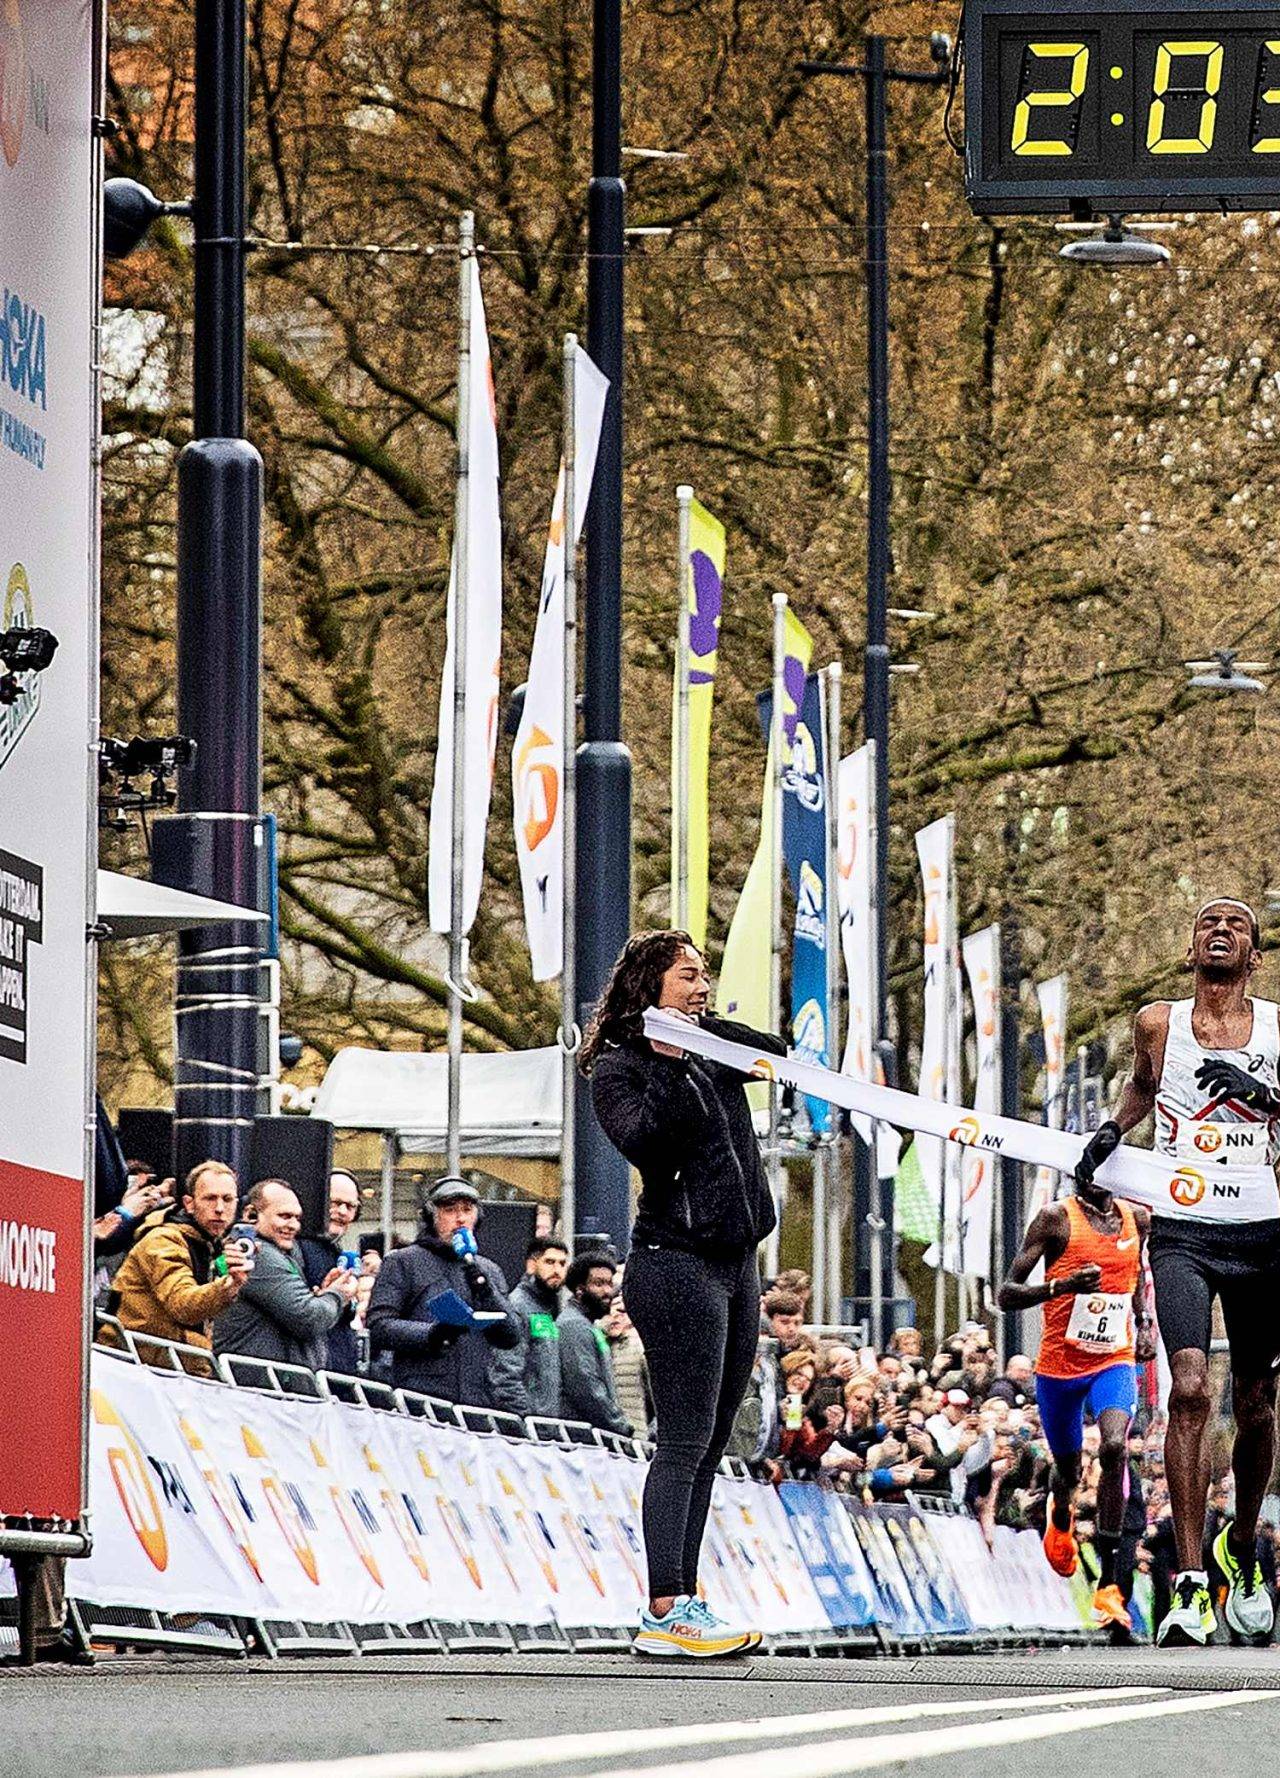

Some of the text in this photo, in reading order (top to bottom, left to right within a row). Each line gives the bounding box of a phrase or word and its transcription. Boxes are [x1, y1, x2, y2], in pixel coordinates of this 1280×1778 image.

[981, 1133, 1004, 1149] NN
[1226, 1133, 1254, 1147] NN
[1213, 1184, 1241, 1198] NN
[1097, 1316, 1109, 1334] 6
